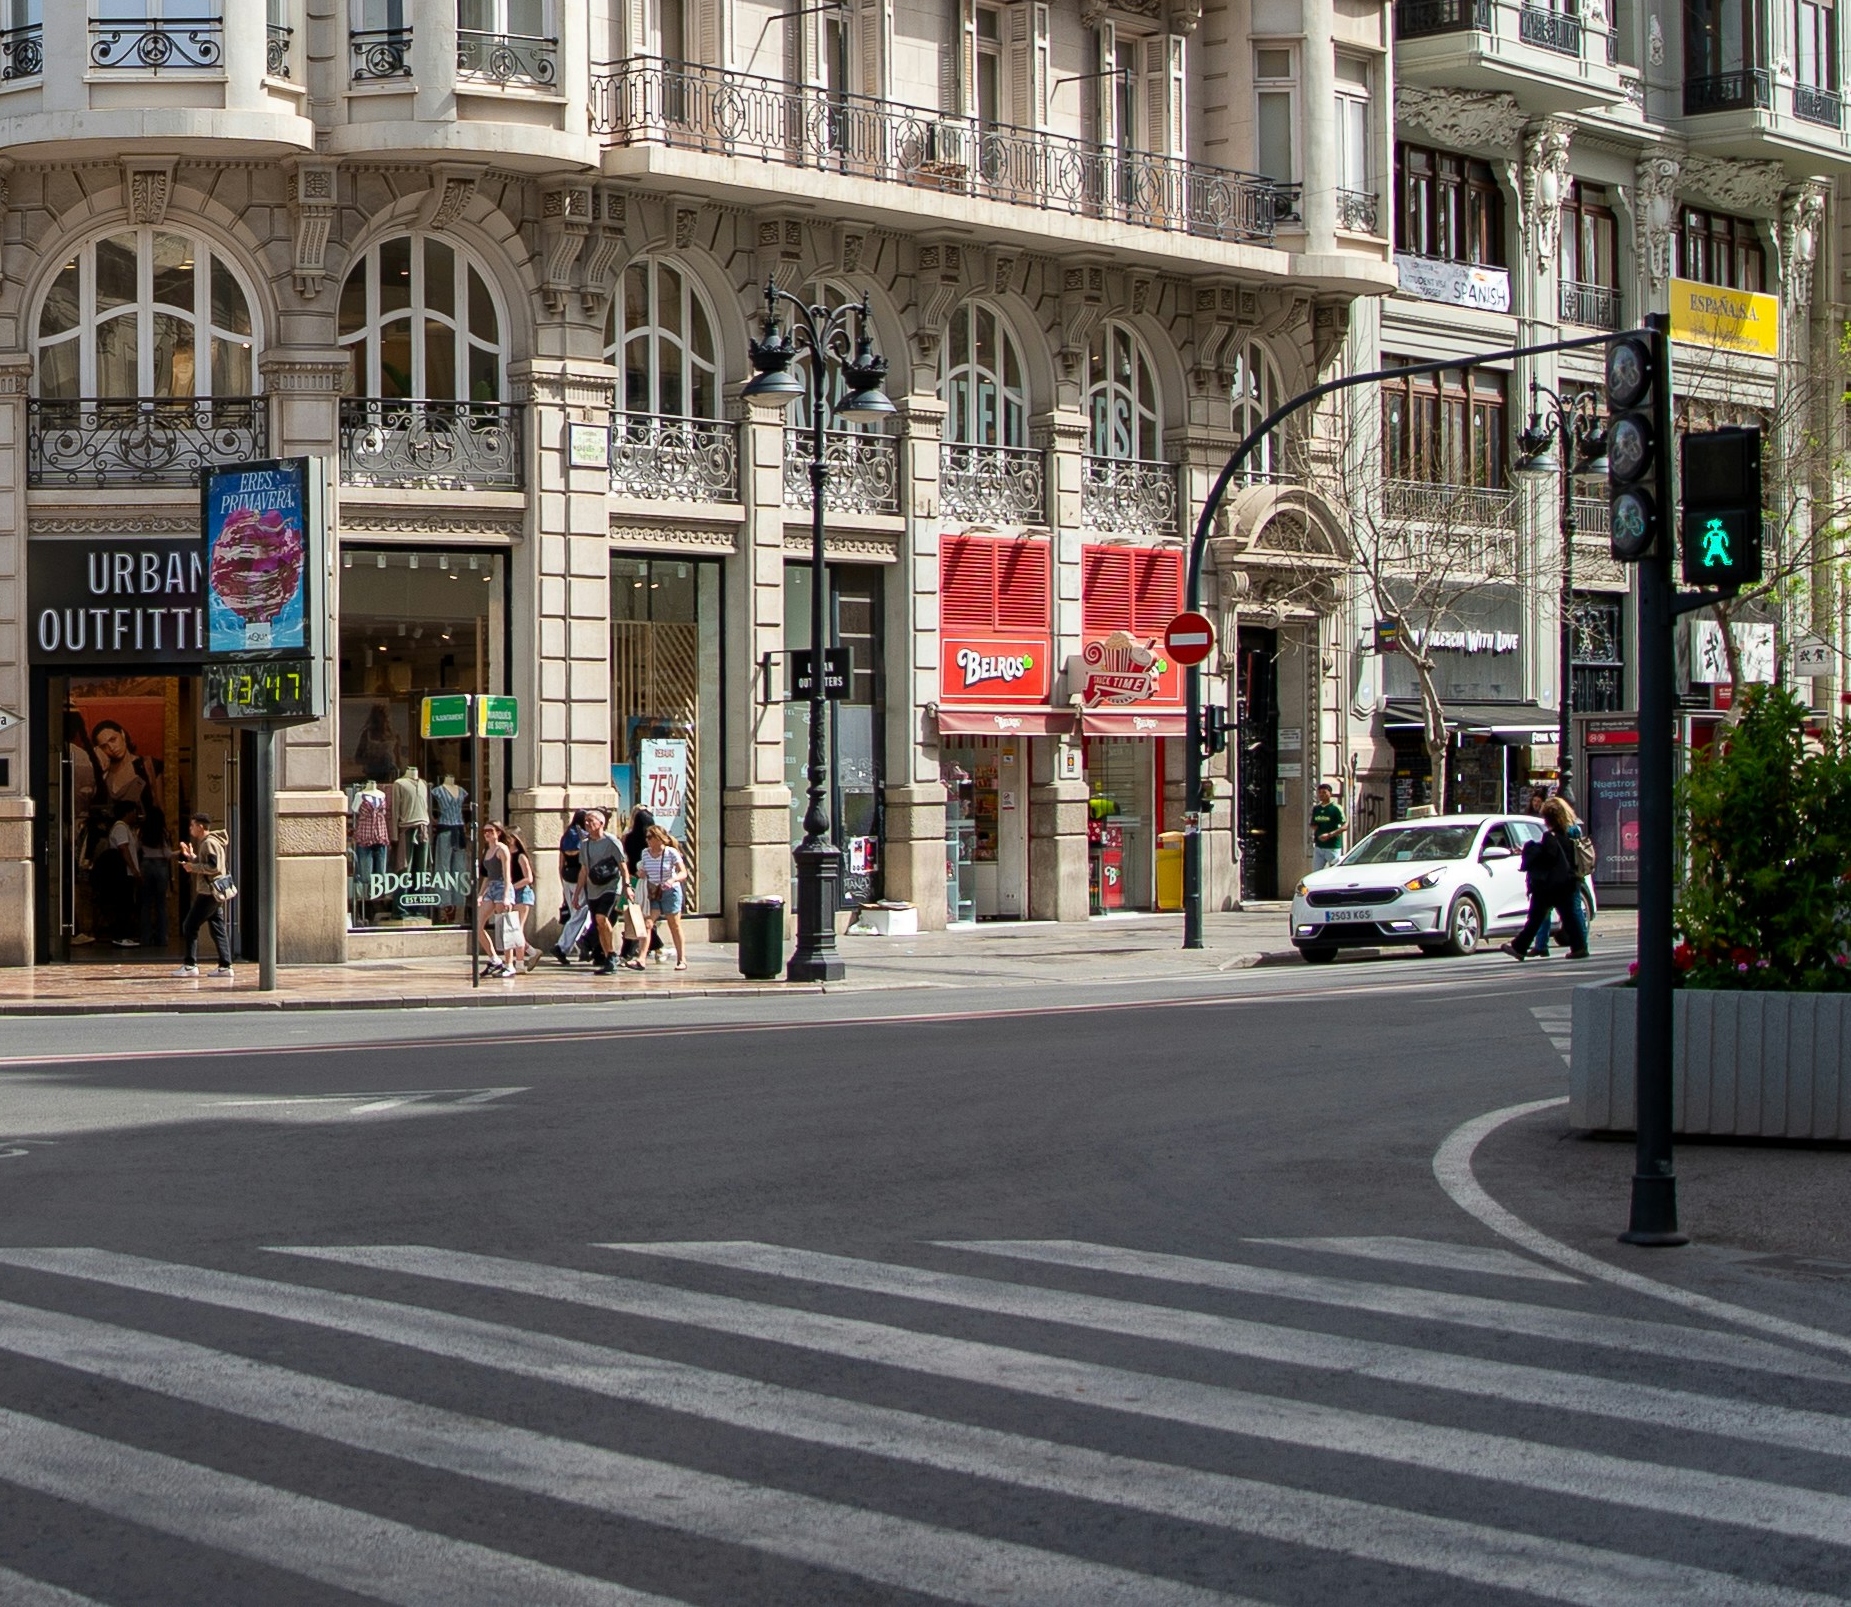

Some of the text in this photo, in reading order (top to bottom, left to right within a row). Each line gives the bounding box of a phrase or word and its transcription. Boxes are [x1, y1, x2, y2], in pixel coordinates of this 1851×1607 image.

[1453, 280, 1506, 306] SPANISH
[1113, 677, 1145, 691] TIME
[649, 773, 681, 807] 75%
[370, 871, 471, 900] BDG JEANS
[1331, 911, 1351, 921] 2503
